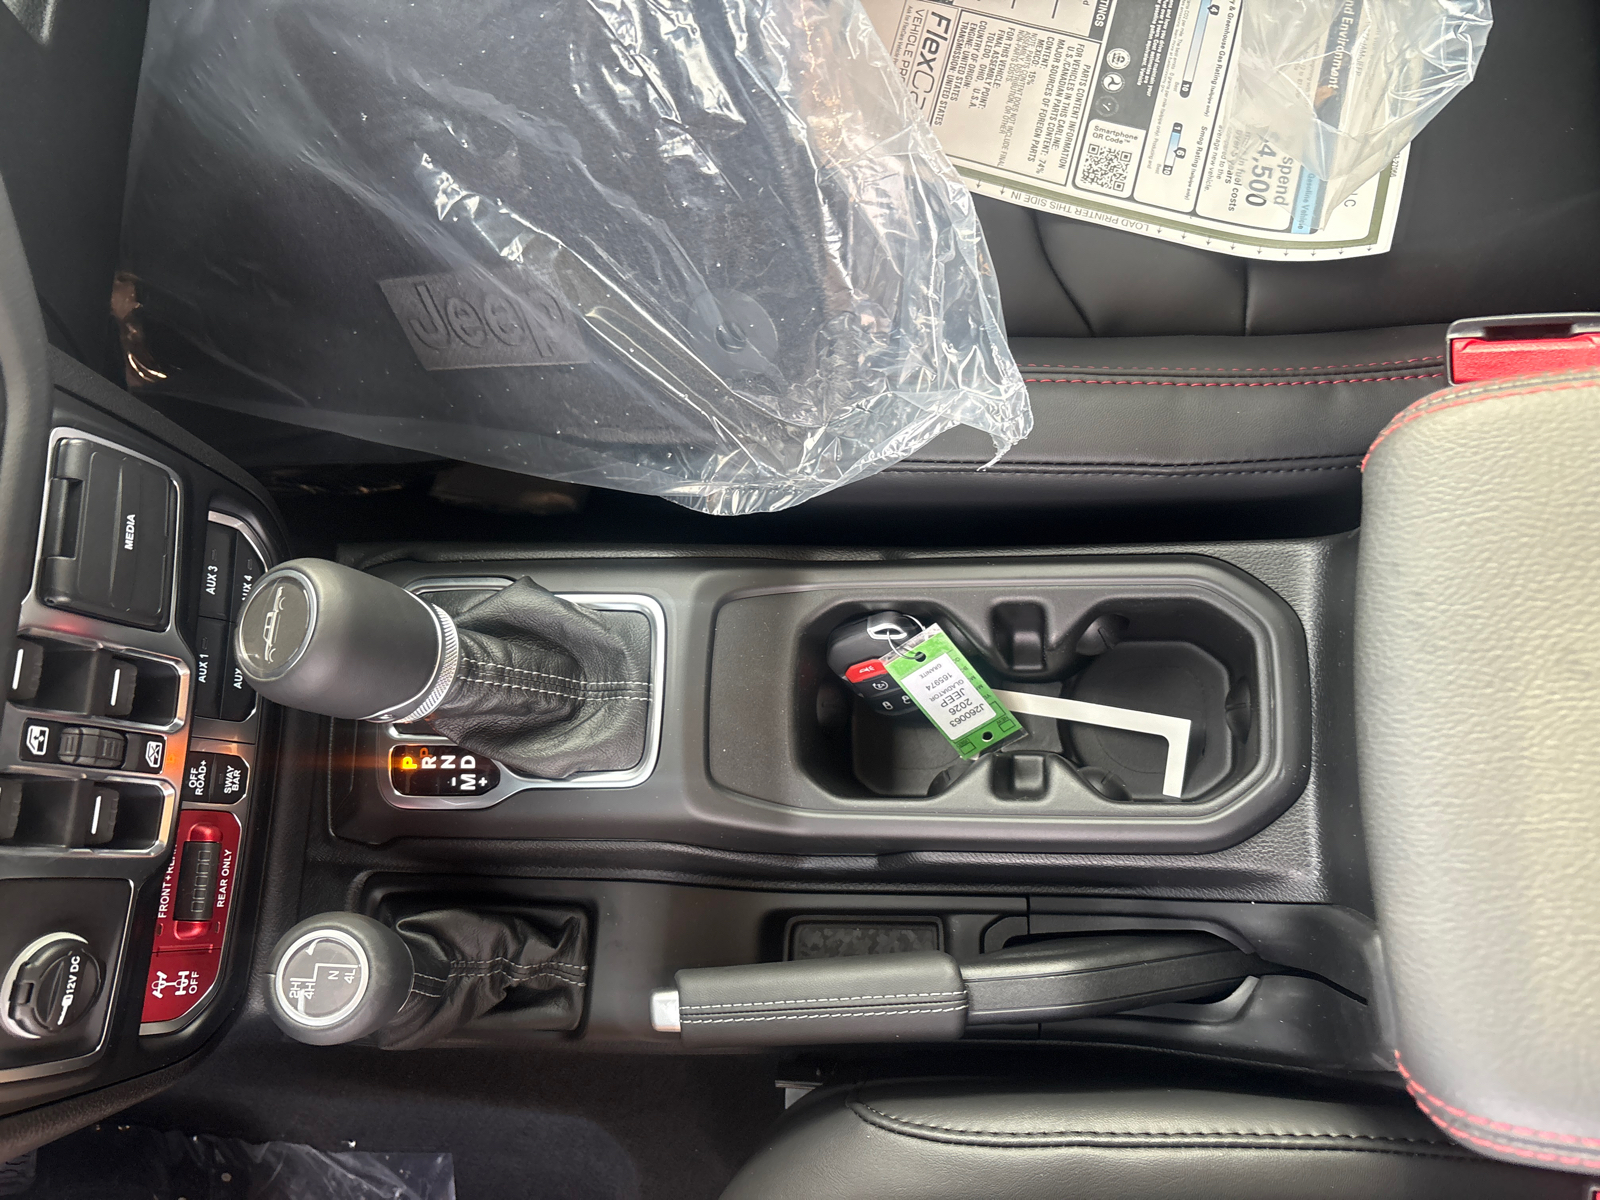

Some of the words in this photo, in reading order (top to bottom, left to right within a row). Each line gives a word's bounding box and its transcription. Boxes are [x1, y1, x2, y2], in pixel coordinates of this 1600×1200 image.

[905, 4, 913, 14] Ask
[898, 21, 909, 41] FlexCare
[902, 7, 925, 58] VEHICLE
[963, 22, 978, 50] ENGINE:
[972, 19, 988, 52] COUNTRY
[992, 29, 1005, 50] FINAL
[1004, 26, 1015, 41] FOR
[1219, 11, 1234, 49] Greenhouse
[893, 40, 903, 58] Vehicle
[948, 19, 969, 74] TRANSMISSION:
[980, 31, 996, 61] TOLEDO,
[1000, 41, 1011, 59] THIS
[1030, 38, 1045, 68] MEXICO:
[1038, 35, 1055, 70] CONTENT:
[1051, 38, 1065, 64] MAJOR
[1073, 42, 1085, 58] FOR
[1216, 49, 1225, 63] Gas
[956, 49, 970, 75] UNITED
[969, 52, 979, 63] OF
[983, 49, 1000, 86] ASSEMBLY
[1022, 49, 1033, 69] PARTS
[962, 62, 976, 90] ORIGIN:
[974, 62, 987, 84] OHIO,
[991, 58, 1007, 90] VEHICLE:
[1015, 69, 1028, 96] CONTENT
[1025, 69, 1037, 86] 15%
[1043, 63, 1059, 97] SOURCES
[1054, 45, 1075, 98] U.S./CANADIAN
[1065, 58, 1081, 92] VEHICLES
[1078, 64, 1091, 87] PARTS
[1210, 63, 1222, 85] Rating
[940, 73, 955, 100] UNITED
[949, 75, 963, 102] STATES
[1062, 92, 1072, 101] IN
[1181, 82, 1190, 92] 10
[967, 87, 980, 110] U.S.A.
[977, 86, 990, 110] POINT:
[1010, 96, 1021, 112] DOES
[1040, 97, 1050, 108] OF
[1069, 87, 1085, 120] CONTENT
[934, 99, 948, 126] STATES
[1003, 105, 1011, 114] OR
[1007, 112, 1017, 124] NOT
[1048, 98, 1061, 121] PARTS
[1058, 101, 1070, 118] THIS
[998, 114, 1009, 134] OTHER
[1032, 108, 1048, 138] FOREIGN
[1093, 124, 1138, 141] Smartphone
[1001, 125, 1014, 150] INCLUDE
[1039, 121, 1055, 156] CONTENT:
[1049, 118, 1066, 151] CARLINE:
[1056, 120, 1077, 169] INFORMATION
[1091, 131, 1104, 140] QR
[1196, 124, 1207, 145] Smog
[1212, 124, 1224, 151] average
[996, 150, 1007, 168] FINAL
[1026, 138, 1040, 162] PARTS
[1190, 145, 1202, 168] Rating
[1209, 151, 1218, 166] new
[1034, 158, 1046, 175] 74%
[1162, 165, 1171, 175] 10
[1215, 168, 1224, 180] the
[1233, 168, 1245, 186] fuel
[1243, 137, 1278, 208] 4,500
[1203, 166, 1215, 192] vehicle.
[1271, 155, 1296, 206] spend
[1302, 172, 1316, 204] Gasoline
[1010, 190, 1022, 200] IN
[1022, 194, 1048, 207] SIDE
[1227, 186, 1240, 212] costs
[1048, 200, 1072, 213] THIS
[1073, 207, 1119, 224] PRINTER
[1120, 218, 1149, 231] LOAD
[408, 281, 565, 358] Jeep
[124, 514, 136, 550] MEDIA
[205, 573, 217, 595] AUX
[198, 661, 208, 683] AUX
[918, 662, 942, 679] GRANITE
[924, 670, 953, 692] 165974
[928, 678, 965, 702] GLADIATOR
[938, 686, 967, 708] JEEP
[947, 697, 972, 716] 2026
[948, 702, 986, 728] J260063
[403, 756, 417, 770] P
[422, 756, 436, 769] R
[440, 755, 456, 769] N
[461, 756, 475, 769] D
[189, 768, 198, 788] OFF
[195, 760, 206, 795] ROAD+
[224, 765, 234, 794] SWAY
[232, 770, 241, 791] BAR
[461, 774, 476, 790] M
[221, 849, 233, 877] ONLY
[217, 880, 229, 907] REAR
[70, 955, 80, 973] DC
[66, 975, 77, 994] 12V
[189, 971, 199, 994] OFF
[328, 971, 339, 980] N
[344, 969, 356, 984] 4L
[289, 982, 301, 998] 2H
[304, 982, 315, 999] 4H
